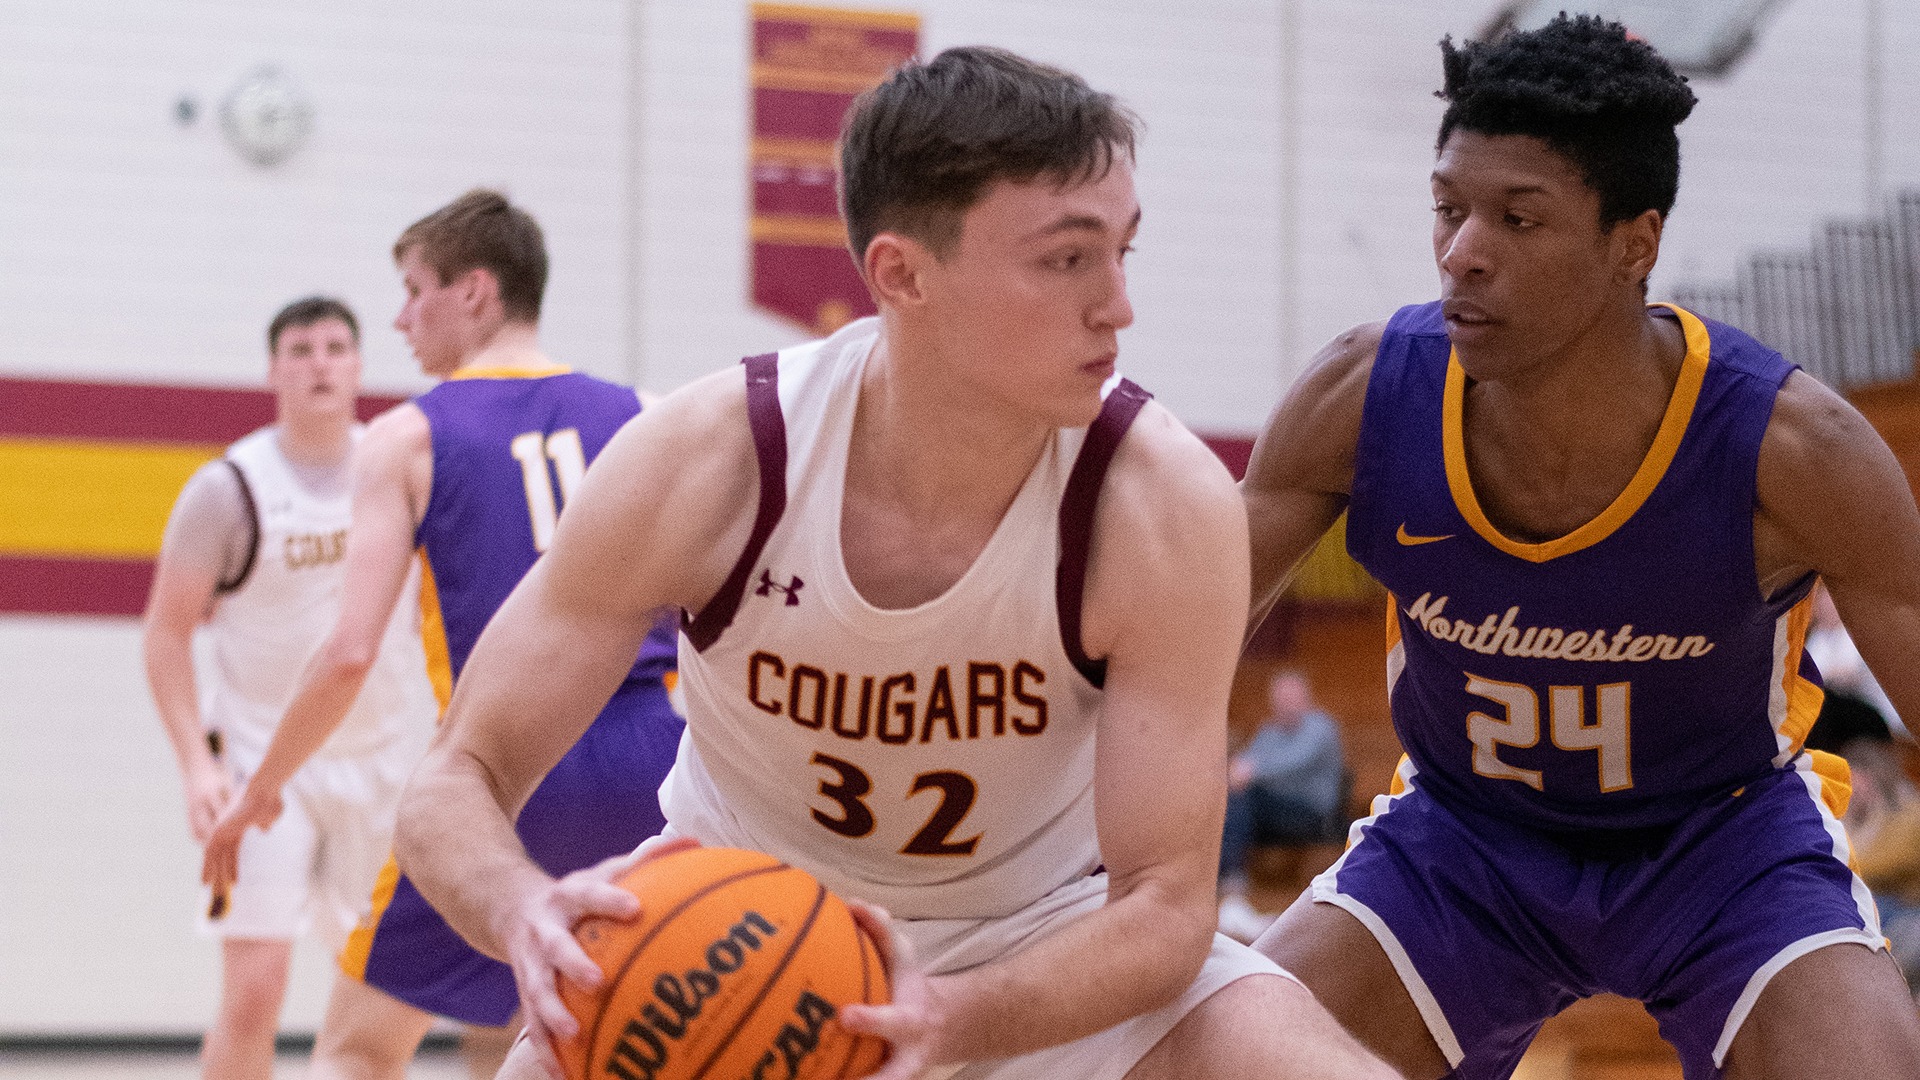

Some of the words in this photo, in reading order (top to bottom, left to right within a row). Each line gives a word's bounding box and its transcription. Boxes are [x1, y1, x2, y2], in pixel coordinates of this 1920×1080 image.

[510, 427, 588, 552] 11
[1402, 591, 1715, 662] Northwestern
[749, 650, 1049, 745] COUGARS
[1463, 671, 1634, 794] 24
[809, 751, 984, 857] 32
[605, 911, 778, 1080] Wilson
